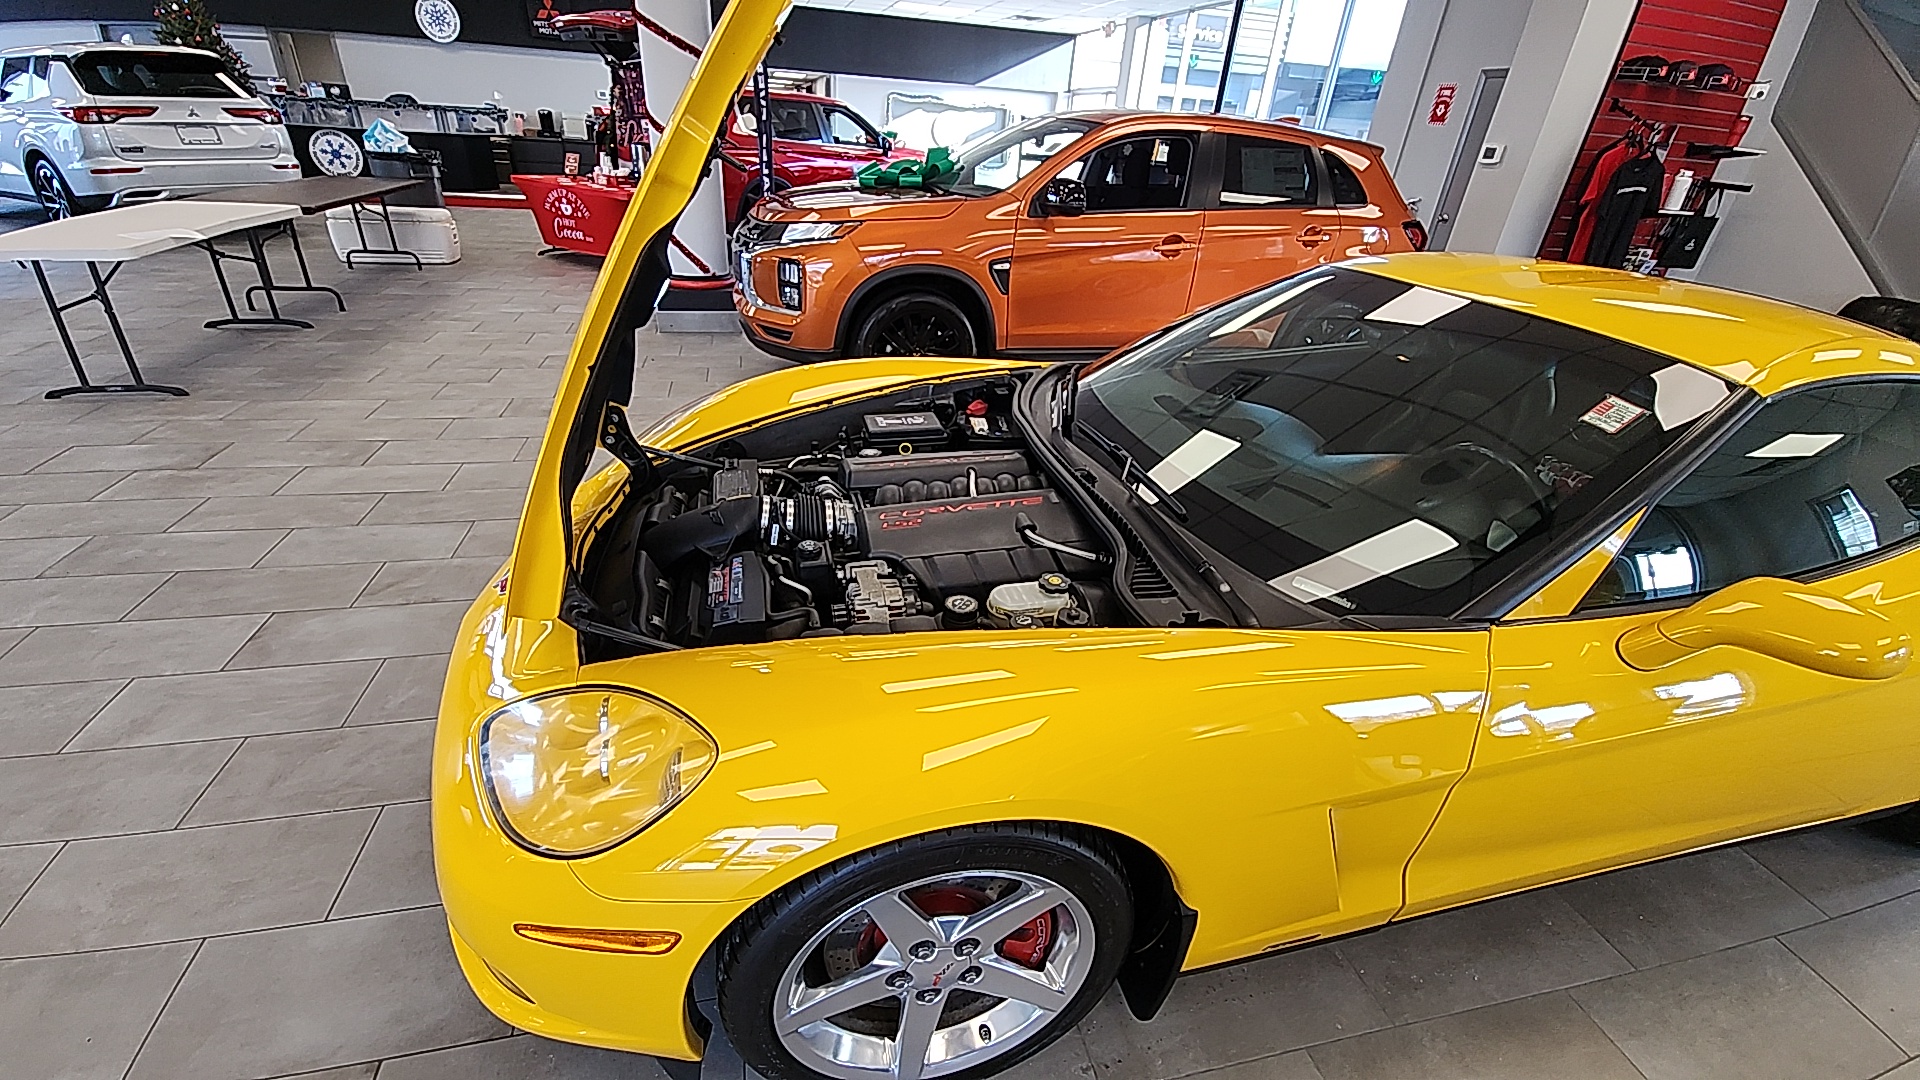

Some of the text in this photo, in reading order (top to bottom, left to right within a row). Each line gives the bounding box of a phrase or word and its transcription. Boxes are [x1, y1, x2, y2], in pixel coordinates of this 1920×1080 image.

[1177, 23, 1224, 43] Srvice
[562, 217, 576, 228] HOT
[879, 496, 1043, 520] CORVETTE
